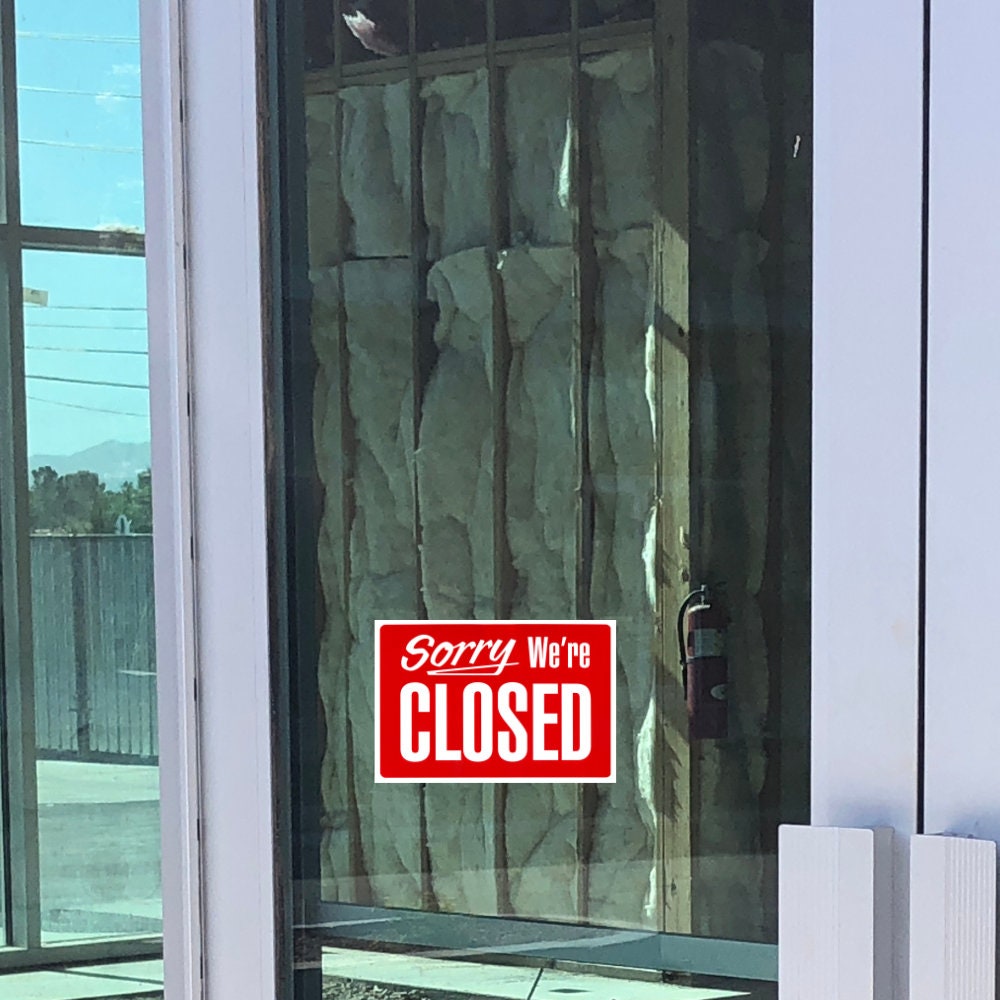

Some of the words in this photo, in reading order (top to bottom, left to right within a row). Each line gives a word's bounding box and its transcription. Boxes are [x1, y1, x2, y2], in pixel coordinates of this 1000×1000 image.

[401, 634, 519, 675] Sorry
[527, 636, 590, 668] We're
[400, 681, 592, 763] CLOSED
